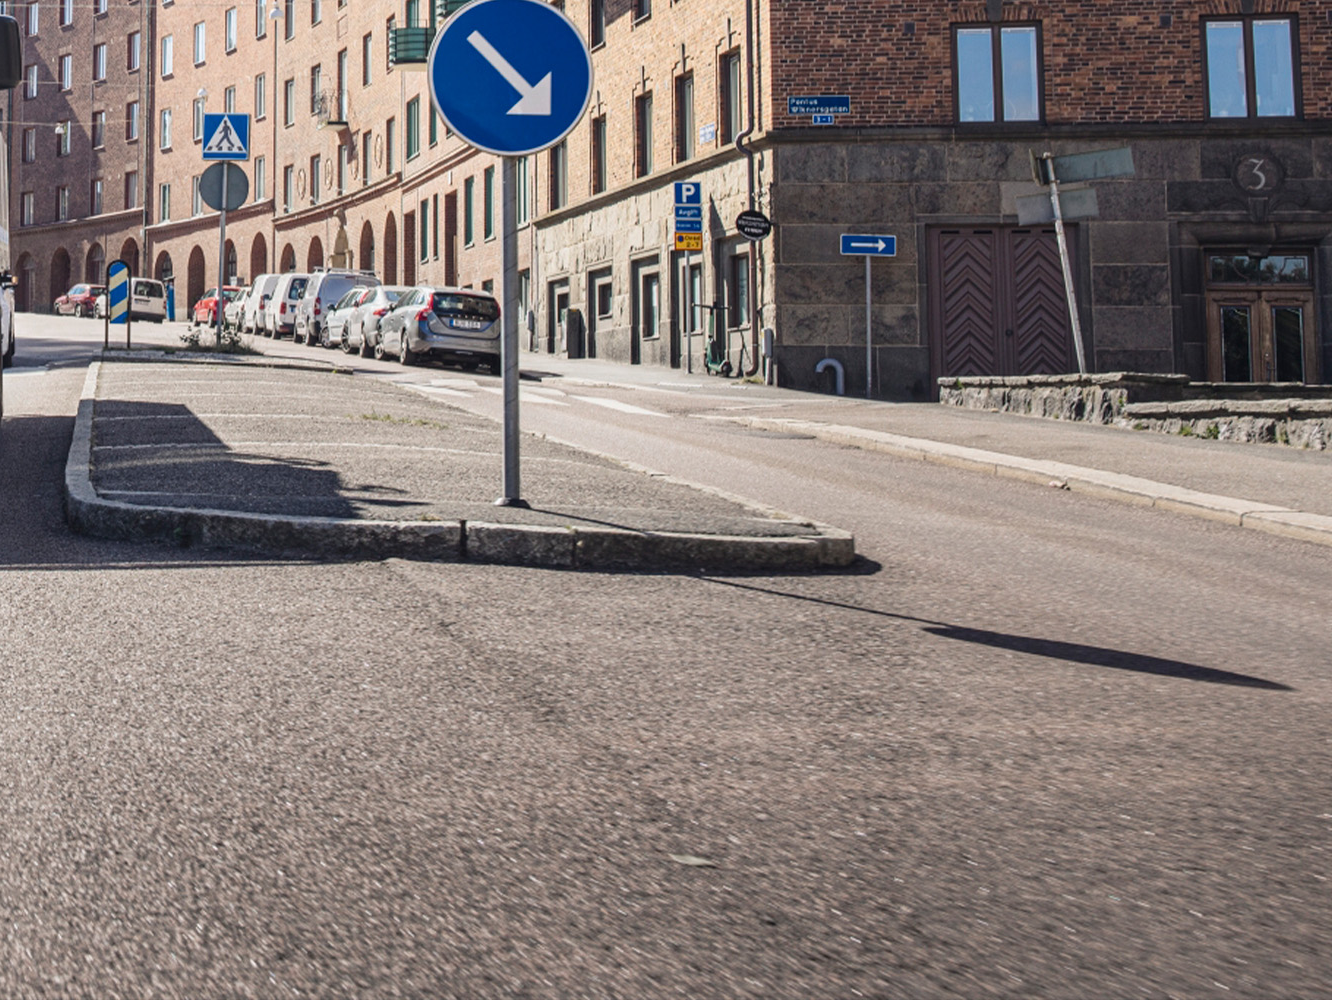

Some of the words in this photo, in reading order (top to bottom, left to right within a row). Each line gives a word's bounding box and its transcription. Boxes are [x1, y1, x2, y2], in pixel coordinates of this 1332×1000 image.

[790, 106, 848, 114] Wiknersgatan
[1247, 158, 1266, 190] 3
[681, 184, 696, 203] P
[678, 208, 699, 217] Avgift
